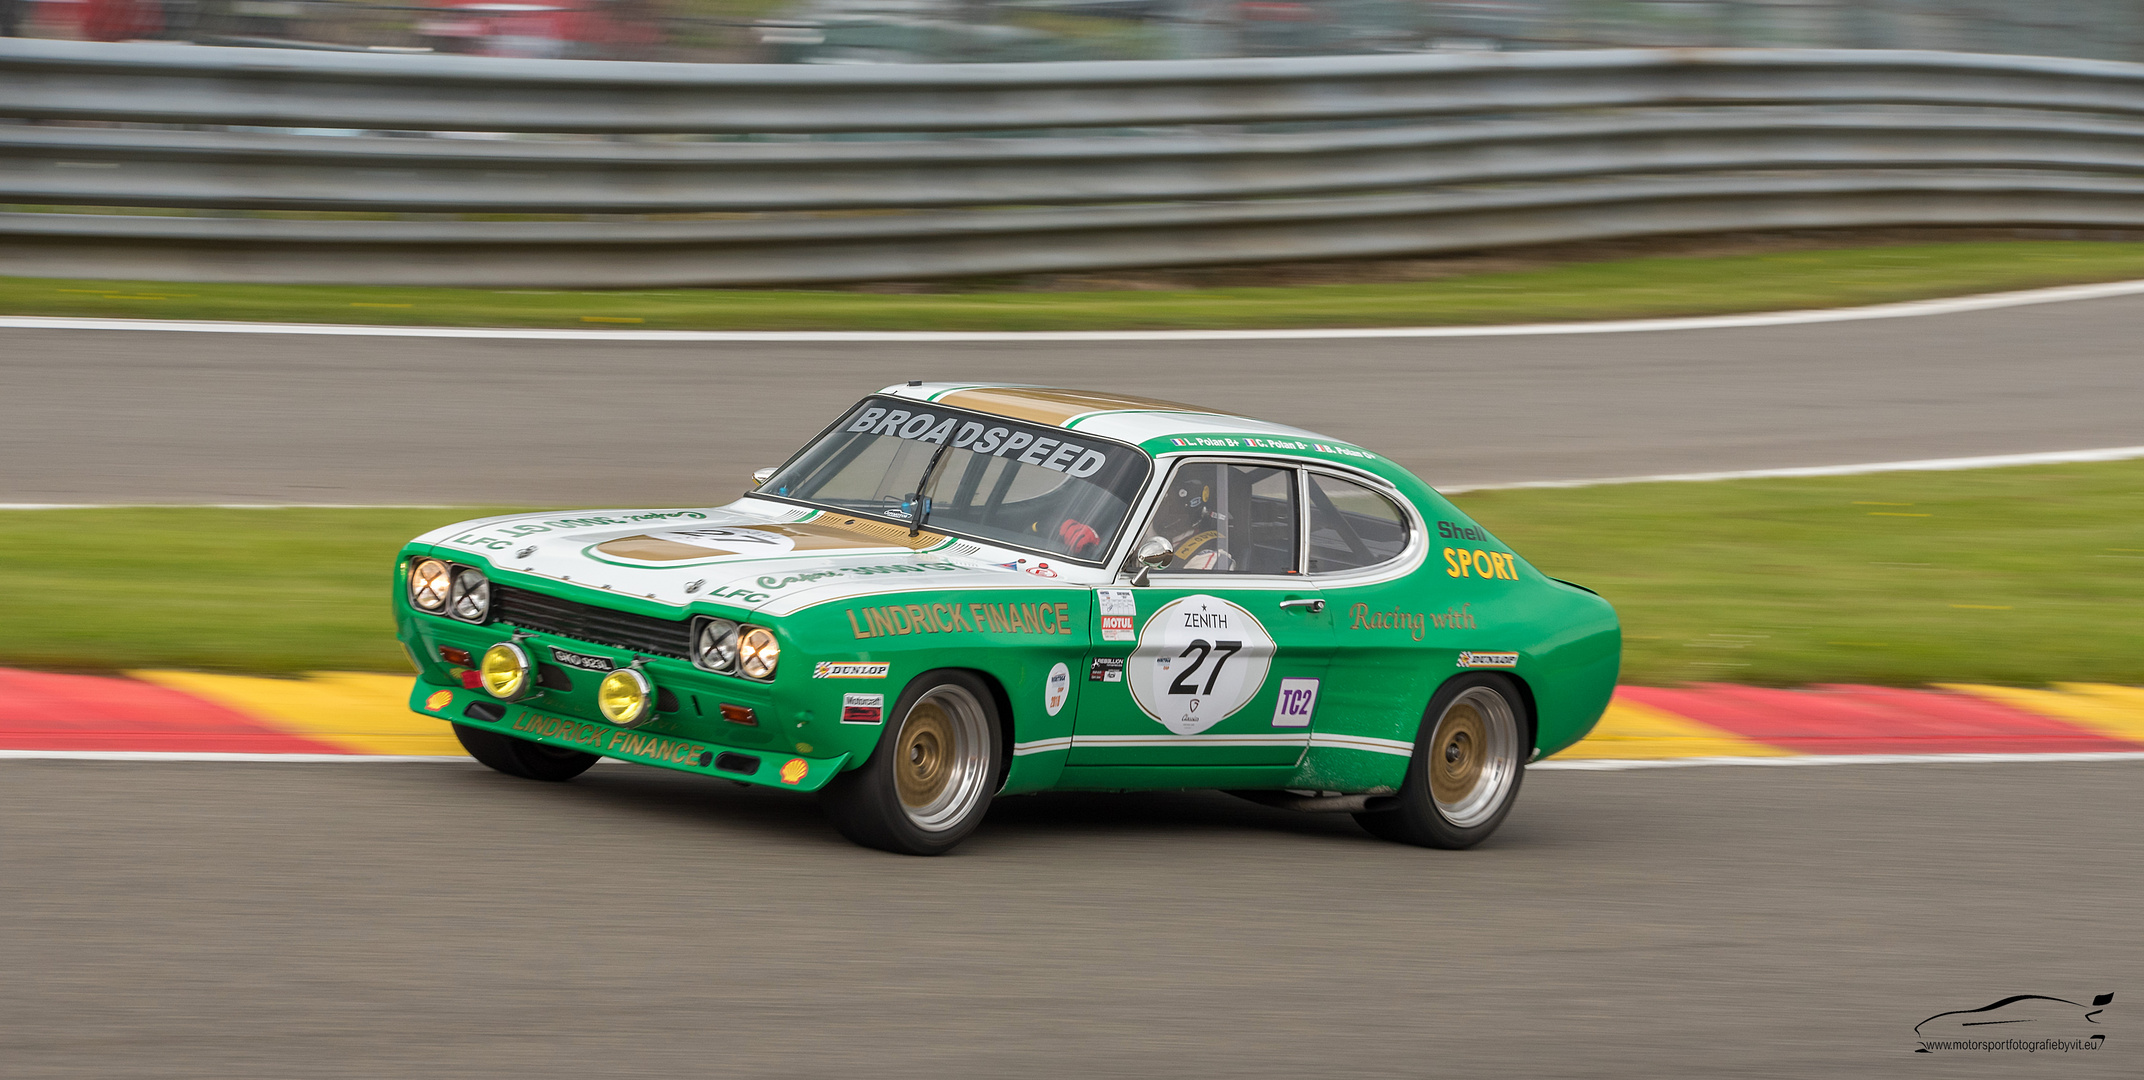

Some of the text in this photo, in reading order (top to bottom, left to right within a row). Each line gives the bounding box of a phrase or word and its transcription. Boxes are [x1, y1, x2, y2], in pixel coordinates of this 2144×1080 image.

[847, 407, 1106, 478] BROADSPEED
[1186, 438, 1240, 447] L. Polan B+
[1257, 439, 1268, 448] C.
[1269, 440, 1296, 449] Polan
[496, 523, 552, 538] GT
[550, 515, 628, 529] 3000
[1437, 520, 1488, 542] Shell
[453, 534, 514, 551] LFC
[839, 563, 924, 576] 3000
[1443, 547, 1519, 581] SPORT
[708, 586, 770, 603] LFC
[846, 602, 1072, 640] LINDRICK FINANCE
[1102, 617, 1132, 629] MOTUL
[1183, 613, 1228, 629] ZENITH
[1349, 602, 1477, 642] Racing with
[1168, 638, 1242, 696] 27
[1471, 655, 1516, 664] DUNLOP
[831, 665, 887, 676] DUNLOP
[1280, 689, 1312, 716] TC2
[513, 711, 705, 767] LINDRICK FINANCE
